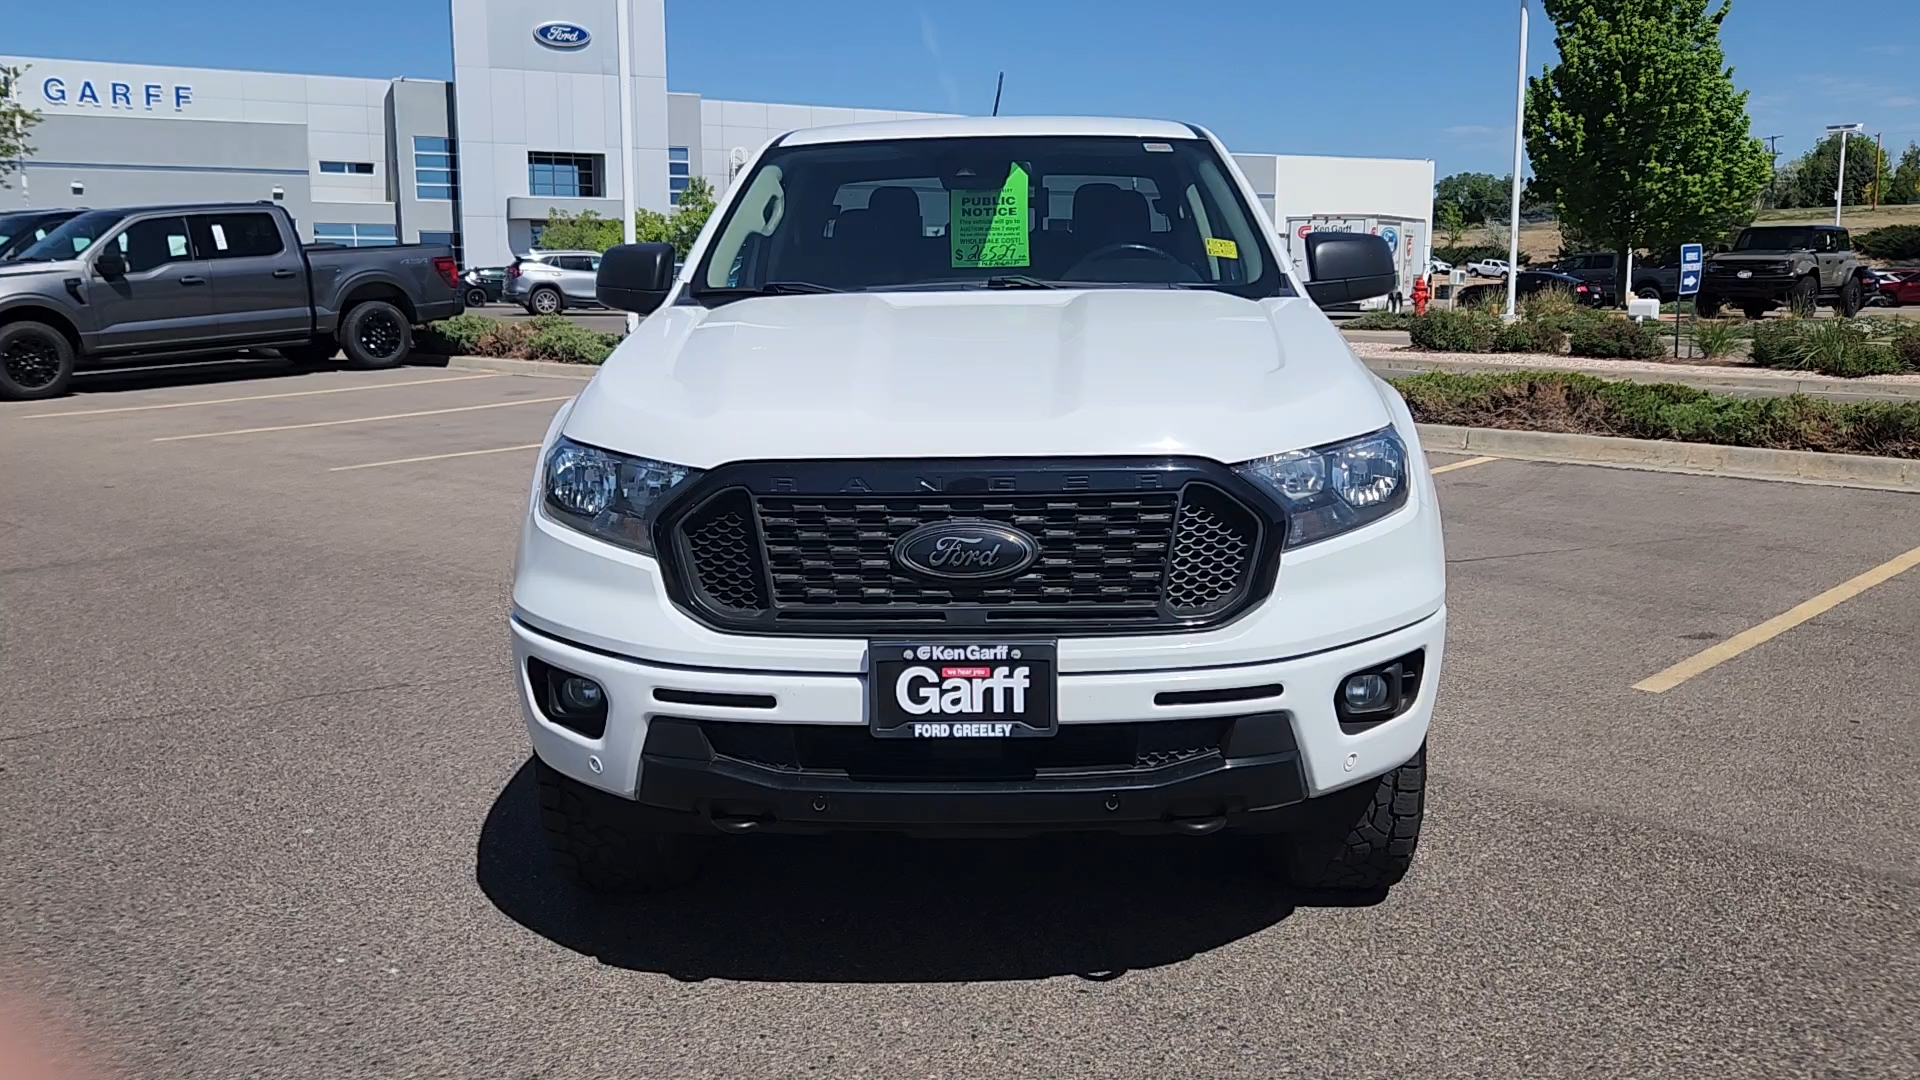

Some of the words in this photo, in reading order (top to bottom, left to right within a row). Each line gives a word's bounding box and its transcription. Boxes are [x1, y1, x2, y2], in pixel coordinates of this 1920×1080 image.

[546, 25, 580, 41] Ford
[43, 77, 192, 109] GARFF
[961, 196, 1016, 206] PUBLIC
[961, 207, 1018, 217] NOTICE
[955, 248, 964, 261] $
[769, 473, 1164, 492] RANGER
[928, 535, 1001, 568] Ford
[932, 646, 965, 660] Ken
[966, 645, 1009, 661] Garff
[973, 669, 985, 677] you
[895, 666, 1030, 715] Garff
[914, 723, 950, 738] FORD
[953, 723, 1012, 738] GREELEY
